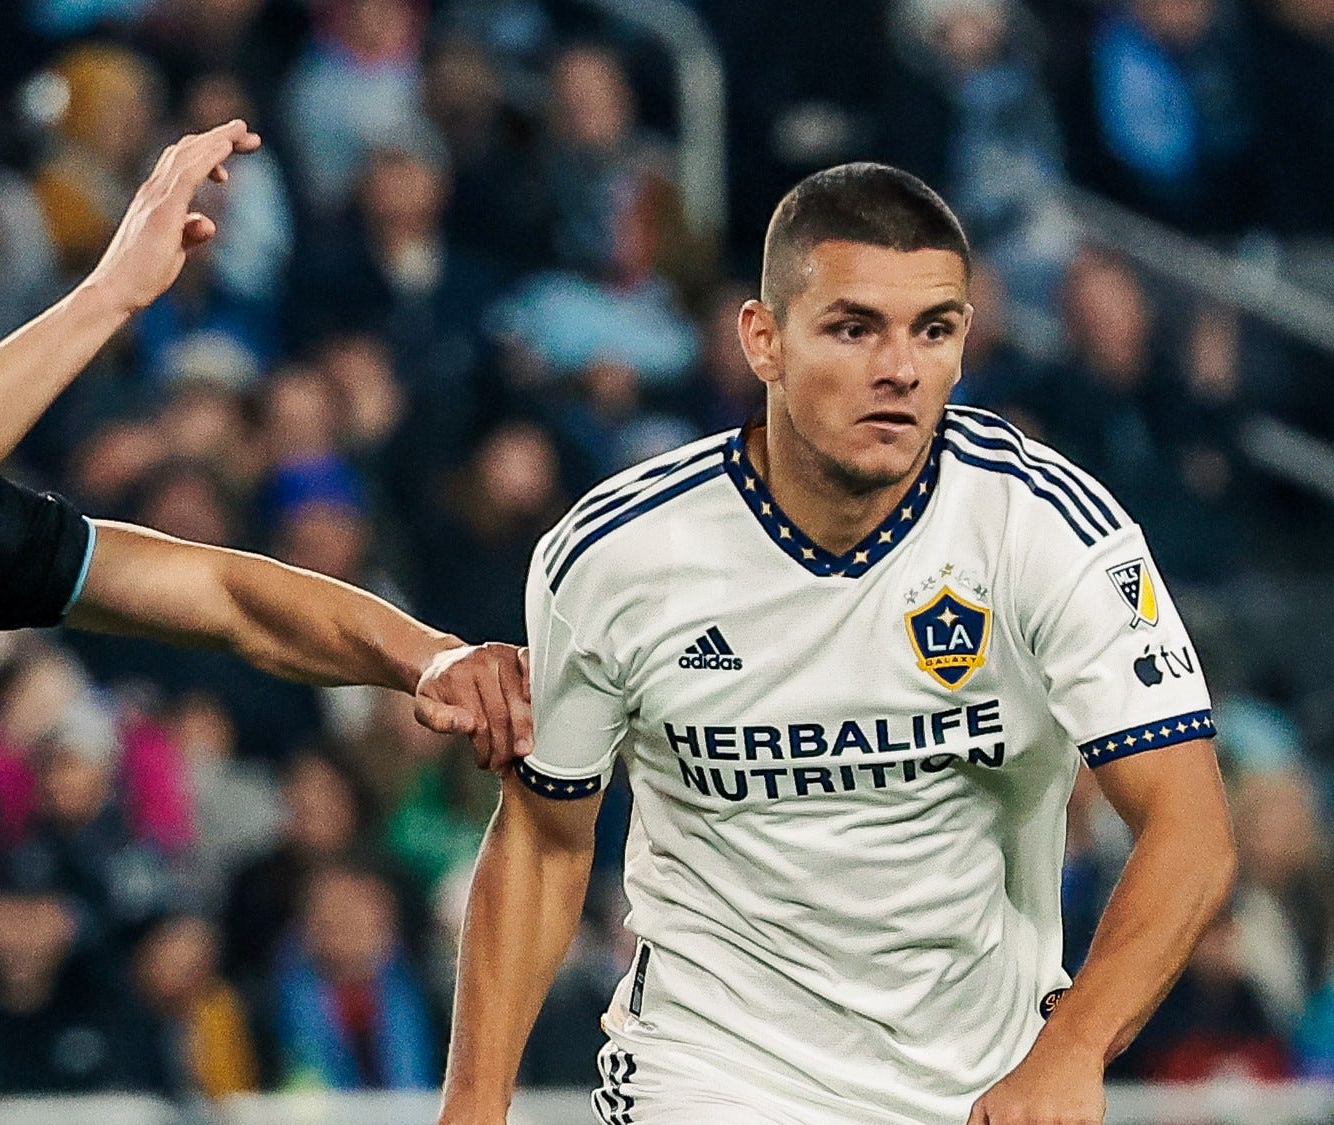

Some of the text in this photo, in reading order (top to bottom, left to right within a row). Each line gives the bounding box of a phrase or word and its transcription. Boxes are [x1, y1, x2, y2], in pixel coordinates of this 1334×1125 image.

[1114, 566, 1139, 585] MLS
[925, 623, 975, 652] LA
[678, 653, 743, 671] adidas
[924, 655, 978, 668] GALAXY
[1159, 644, 1195, 678] tv
[664, 699, 1004, 762] HERBALIFE
[677, 741, 1006, 802] NUTRITION
